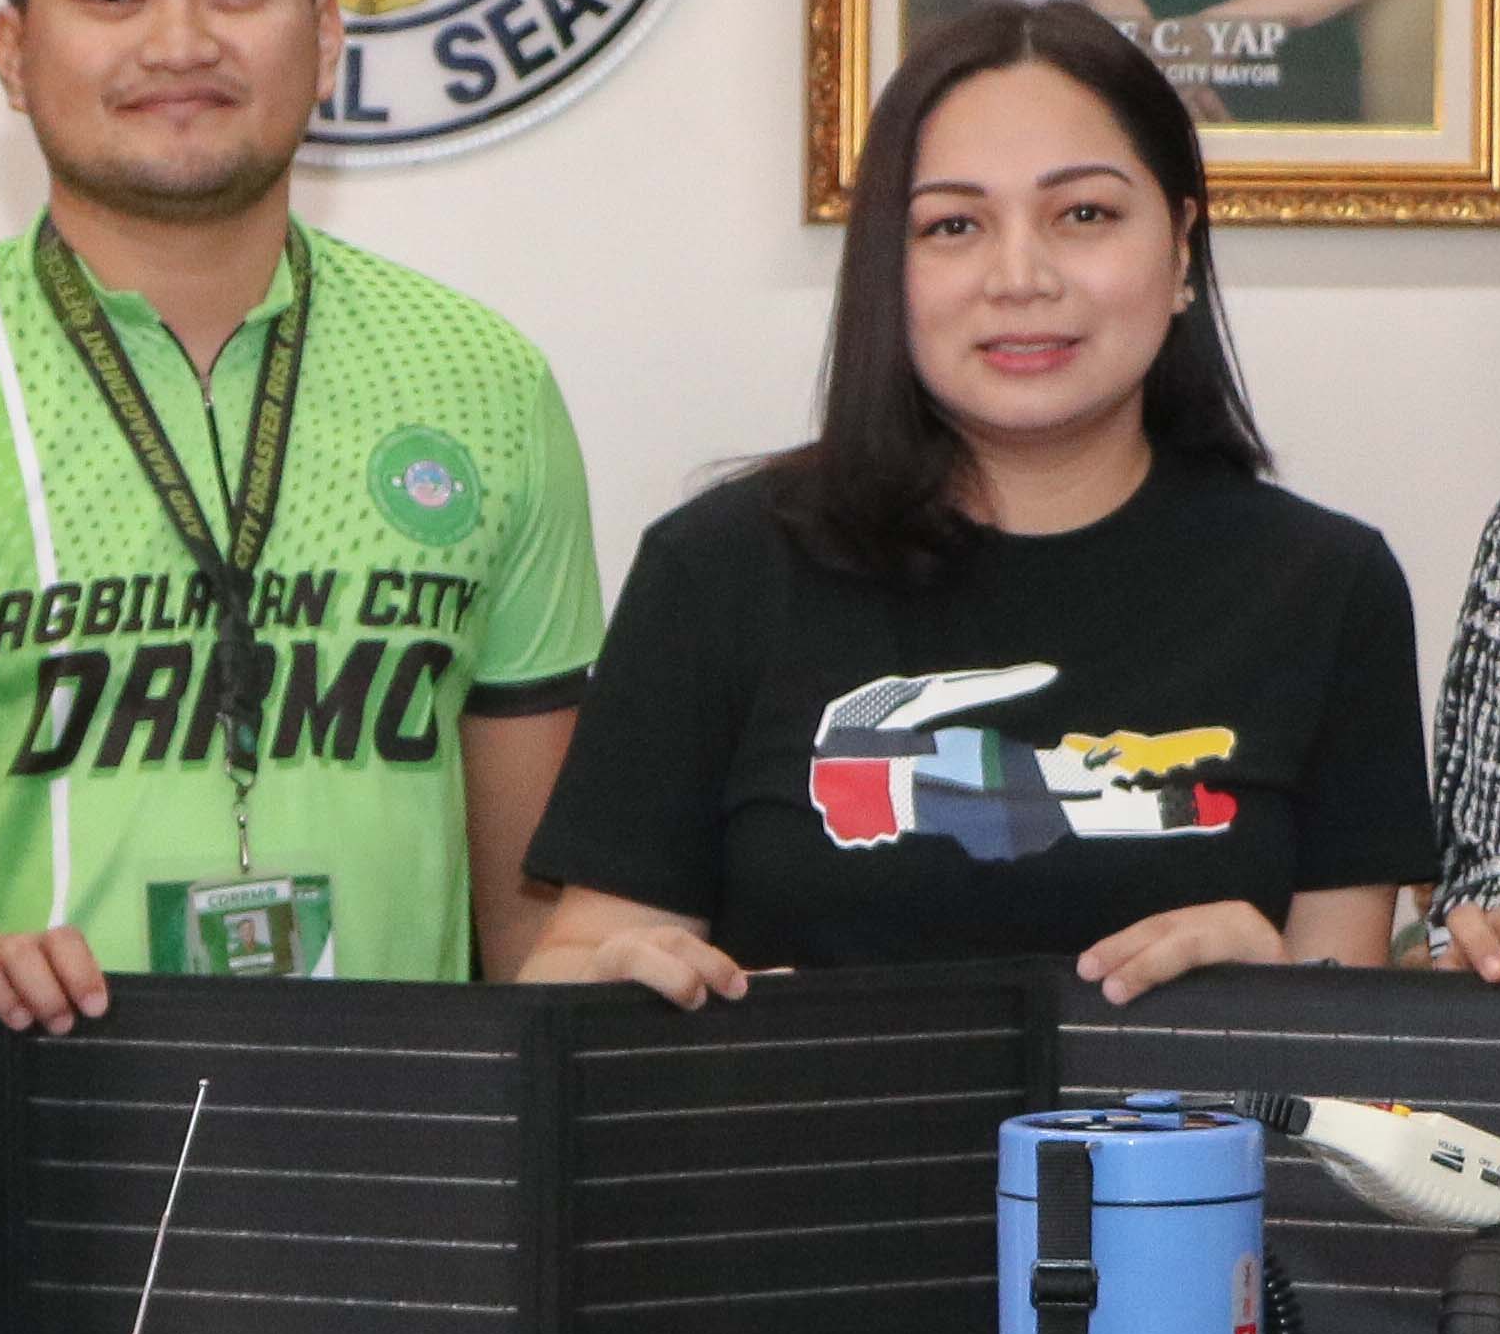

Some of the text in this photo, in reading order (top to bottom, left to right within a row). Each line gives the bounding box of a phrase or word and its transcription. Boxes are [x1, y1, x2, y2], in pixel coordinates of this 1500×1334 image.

[1150, 18, 1192, 58] C.
[1204, 19, 1289, 58] YAP
[1164, 63, 1282, 86] CITY MAYOR
[79, 330, 179, 486] MANAGEMENT
[245, 398, 283, 515] DISASTER
[234, 513, 262, 571] CITY
[357, 571, 483, 637] CITY
